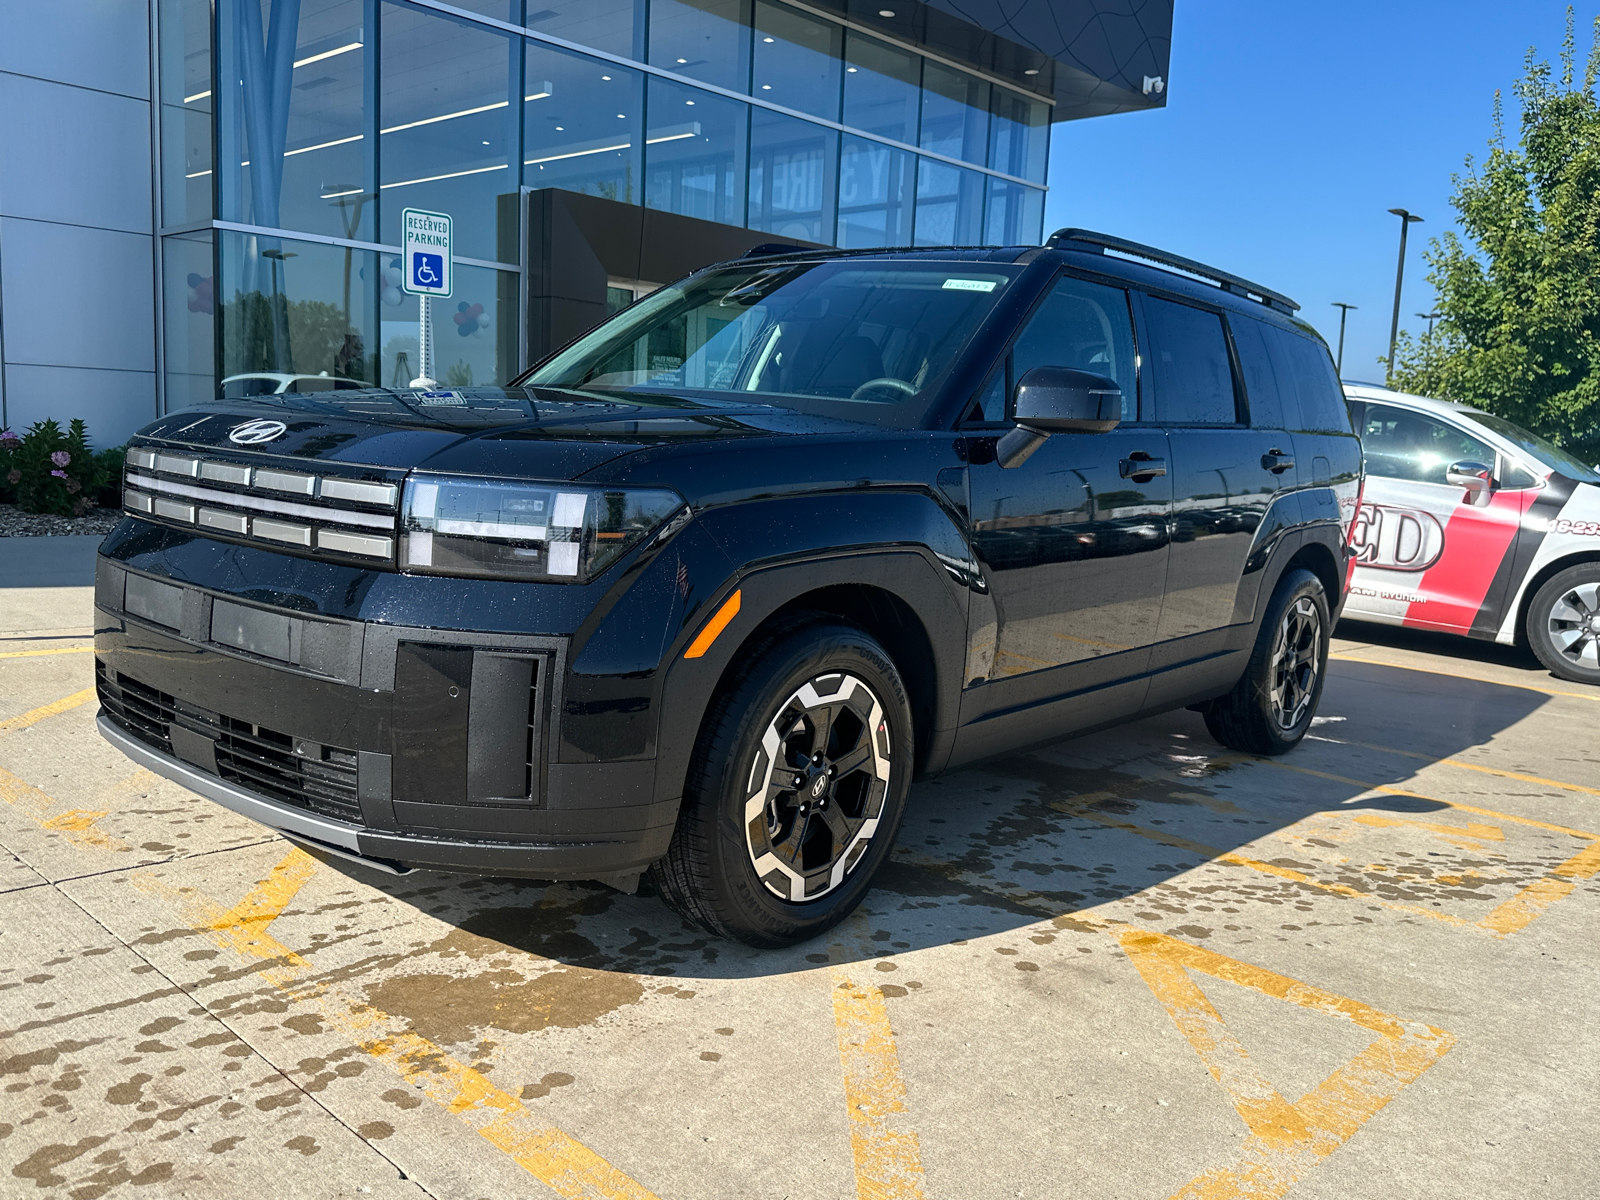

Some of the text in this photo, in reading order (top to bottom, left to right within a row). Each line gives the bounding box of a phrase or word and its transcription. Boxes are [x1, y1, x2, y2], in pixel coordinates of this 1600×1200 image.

[408, 217, 448, 234] RESERVED
[408, 231, 448, 248] PARKING
[1547, 519, 1600, 536] 16-23
[1381, 591, 1428, 604] HYUNDAI
[859, 647, 906, 706] GOODYEAR
[736, 880, 798, 934] ASSURANCE
